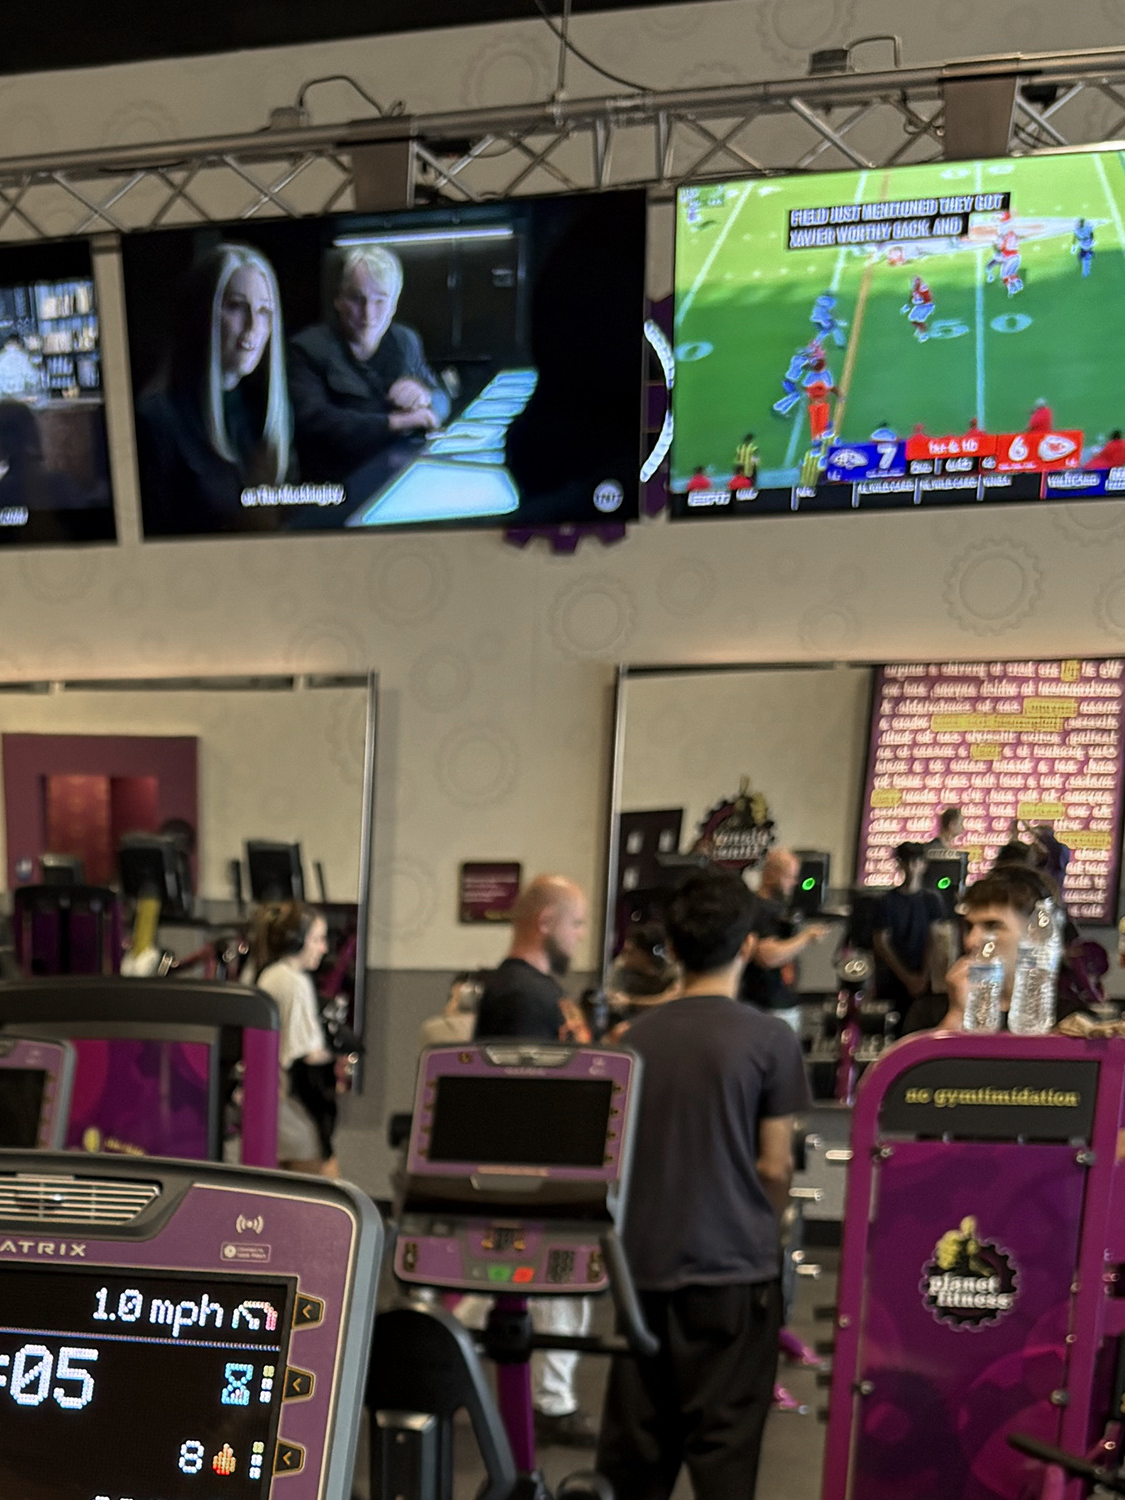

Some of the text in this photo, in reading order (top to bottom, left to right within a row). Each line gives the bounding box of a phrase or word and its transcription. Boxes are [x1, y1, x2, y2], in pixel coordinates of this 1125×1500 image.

[791, 193, 1004, 227] FIELD JUST MENTIONED THEY GOT
[790, 227, 835, 247] XAVIER
[836, 223, 891, 244] WORTHY
[932, 216, 963, 236] AND
[877, 442, 897, 469] 7
[1009, 436, 1028, 462] 6
[928, 1273, 1001, 1296] planet
[92, 1287, 224, 1338] 1.0 mph
[936, 1291, 1013, 1310] fitness
[179, 1440, 204, 1474] 8
